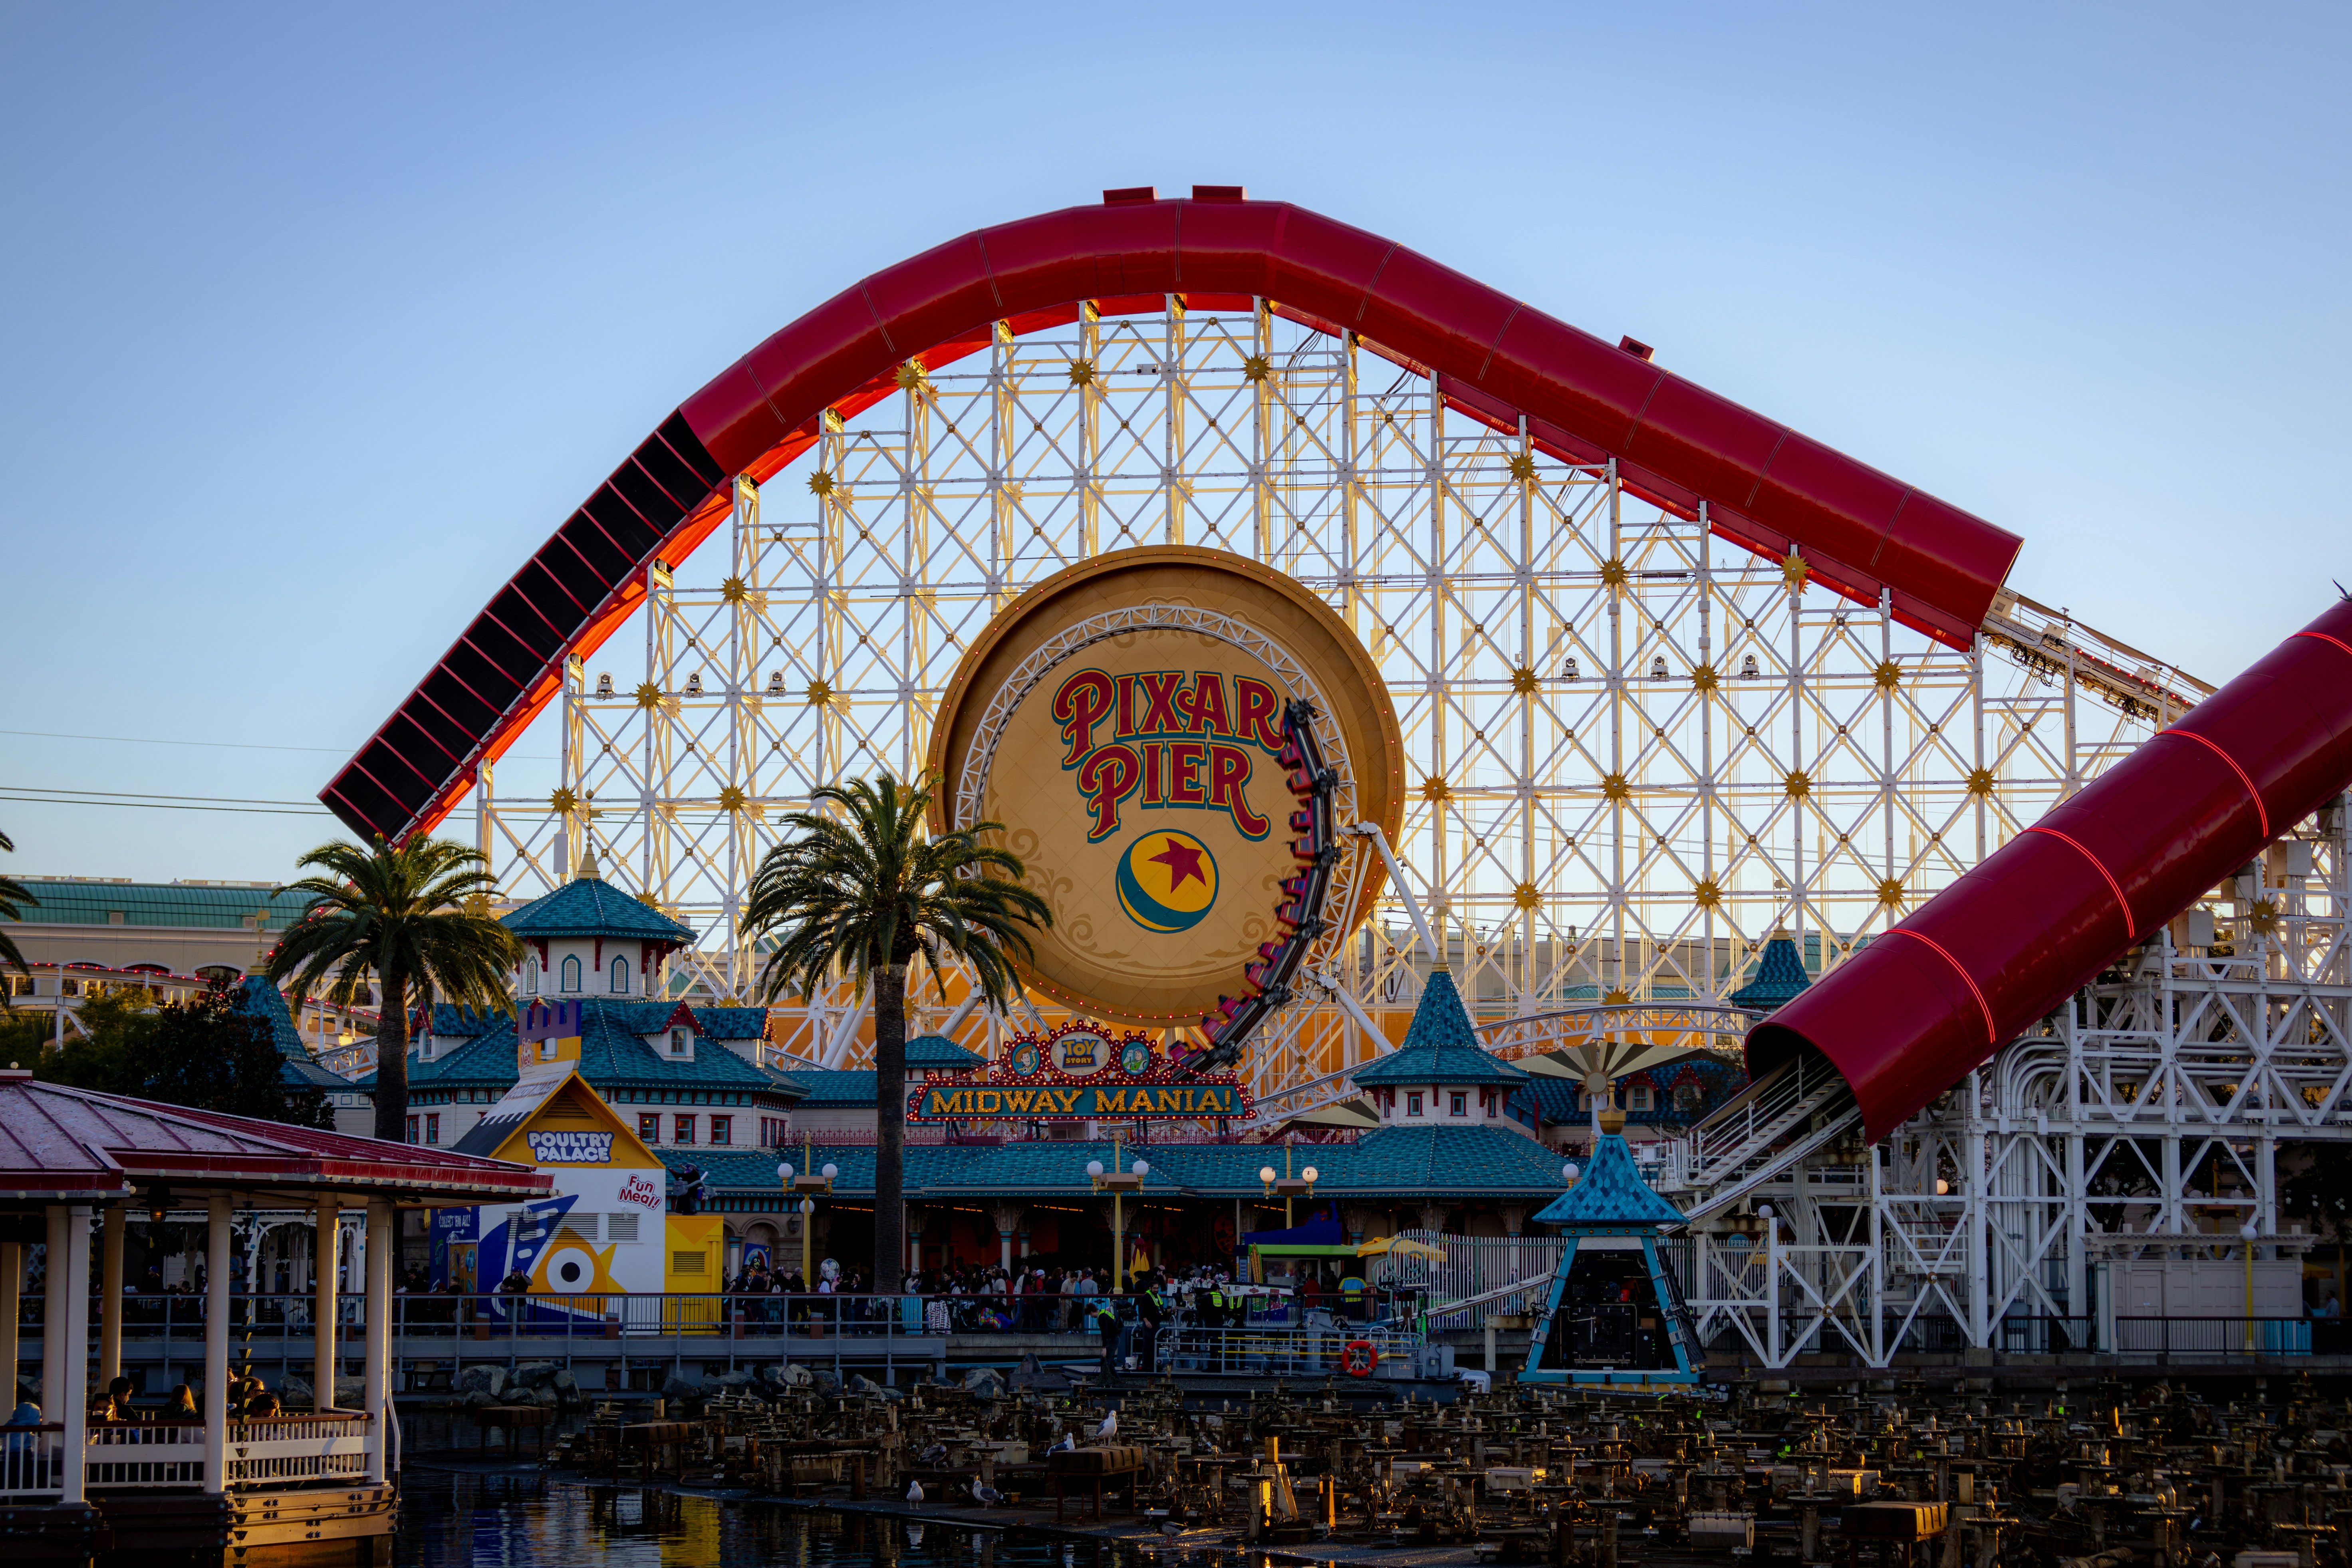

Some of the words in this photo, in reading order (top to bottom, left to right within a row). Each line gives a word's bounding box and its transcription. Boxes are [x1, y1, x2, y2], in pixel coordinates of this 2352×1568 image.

[1052, 668, 1286, 768] PIXAR
[1078, 743, 1270, 841] PIER
[522, 1038, 532, 1054] Fun
[1062, 1039, 1098, 1056] TOY
[931, 1089, 1083, 1113] MIDWAY
[1095, 1089, 1231, 1112] MANIA!
[529, 1132, 612, 1147] POULTRY
[537, 1147, 609, 1161] PALACE
[629, 1175, 654, 1193] Fun
[619, 1188, 661, 1209] Meal!
